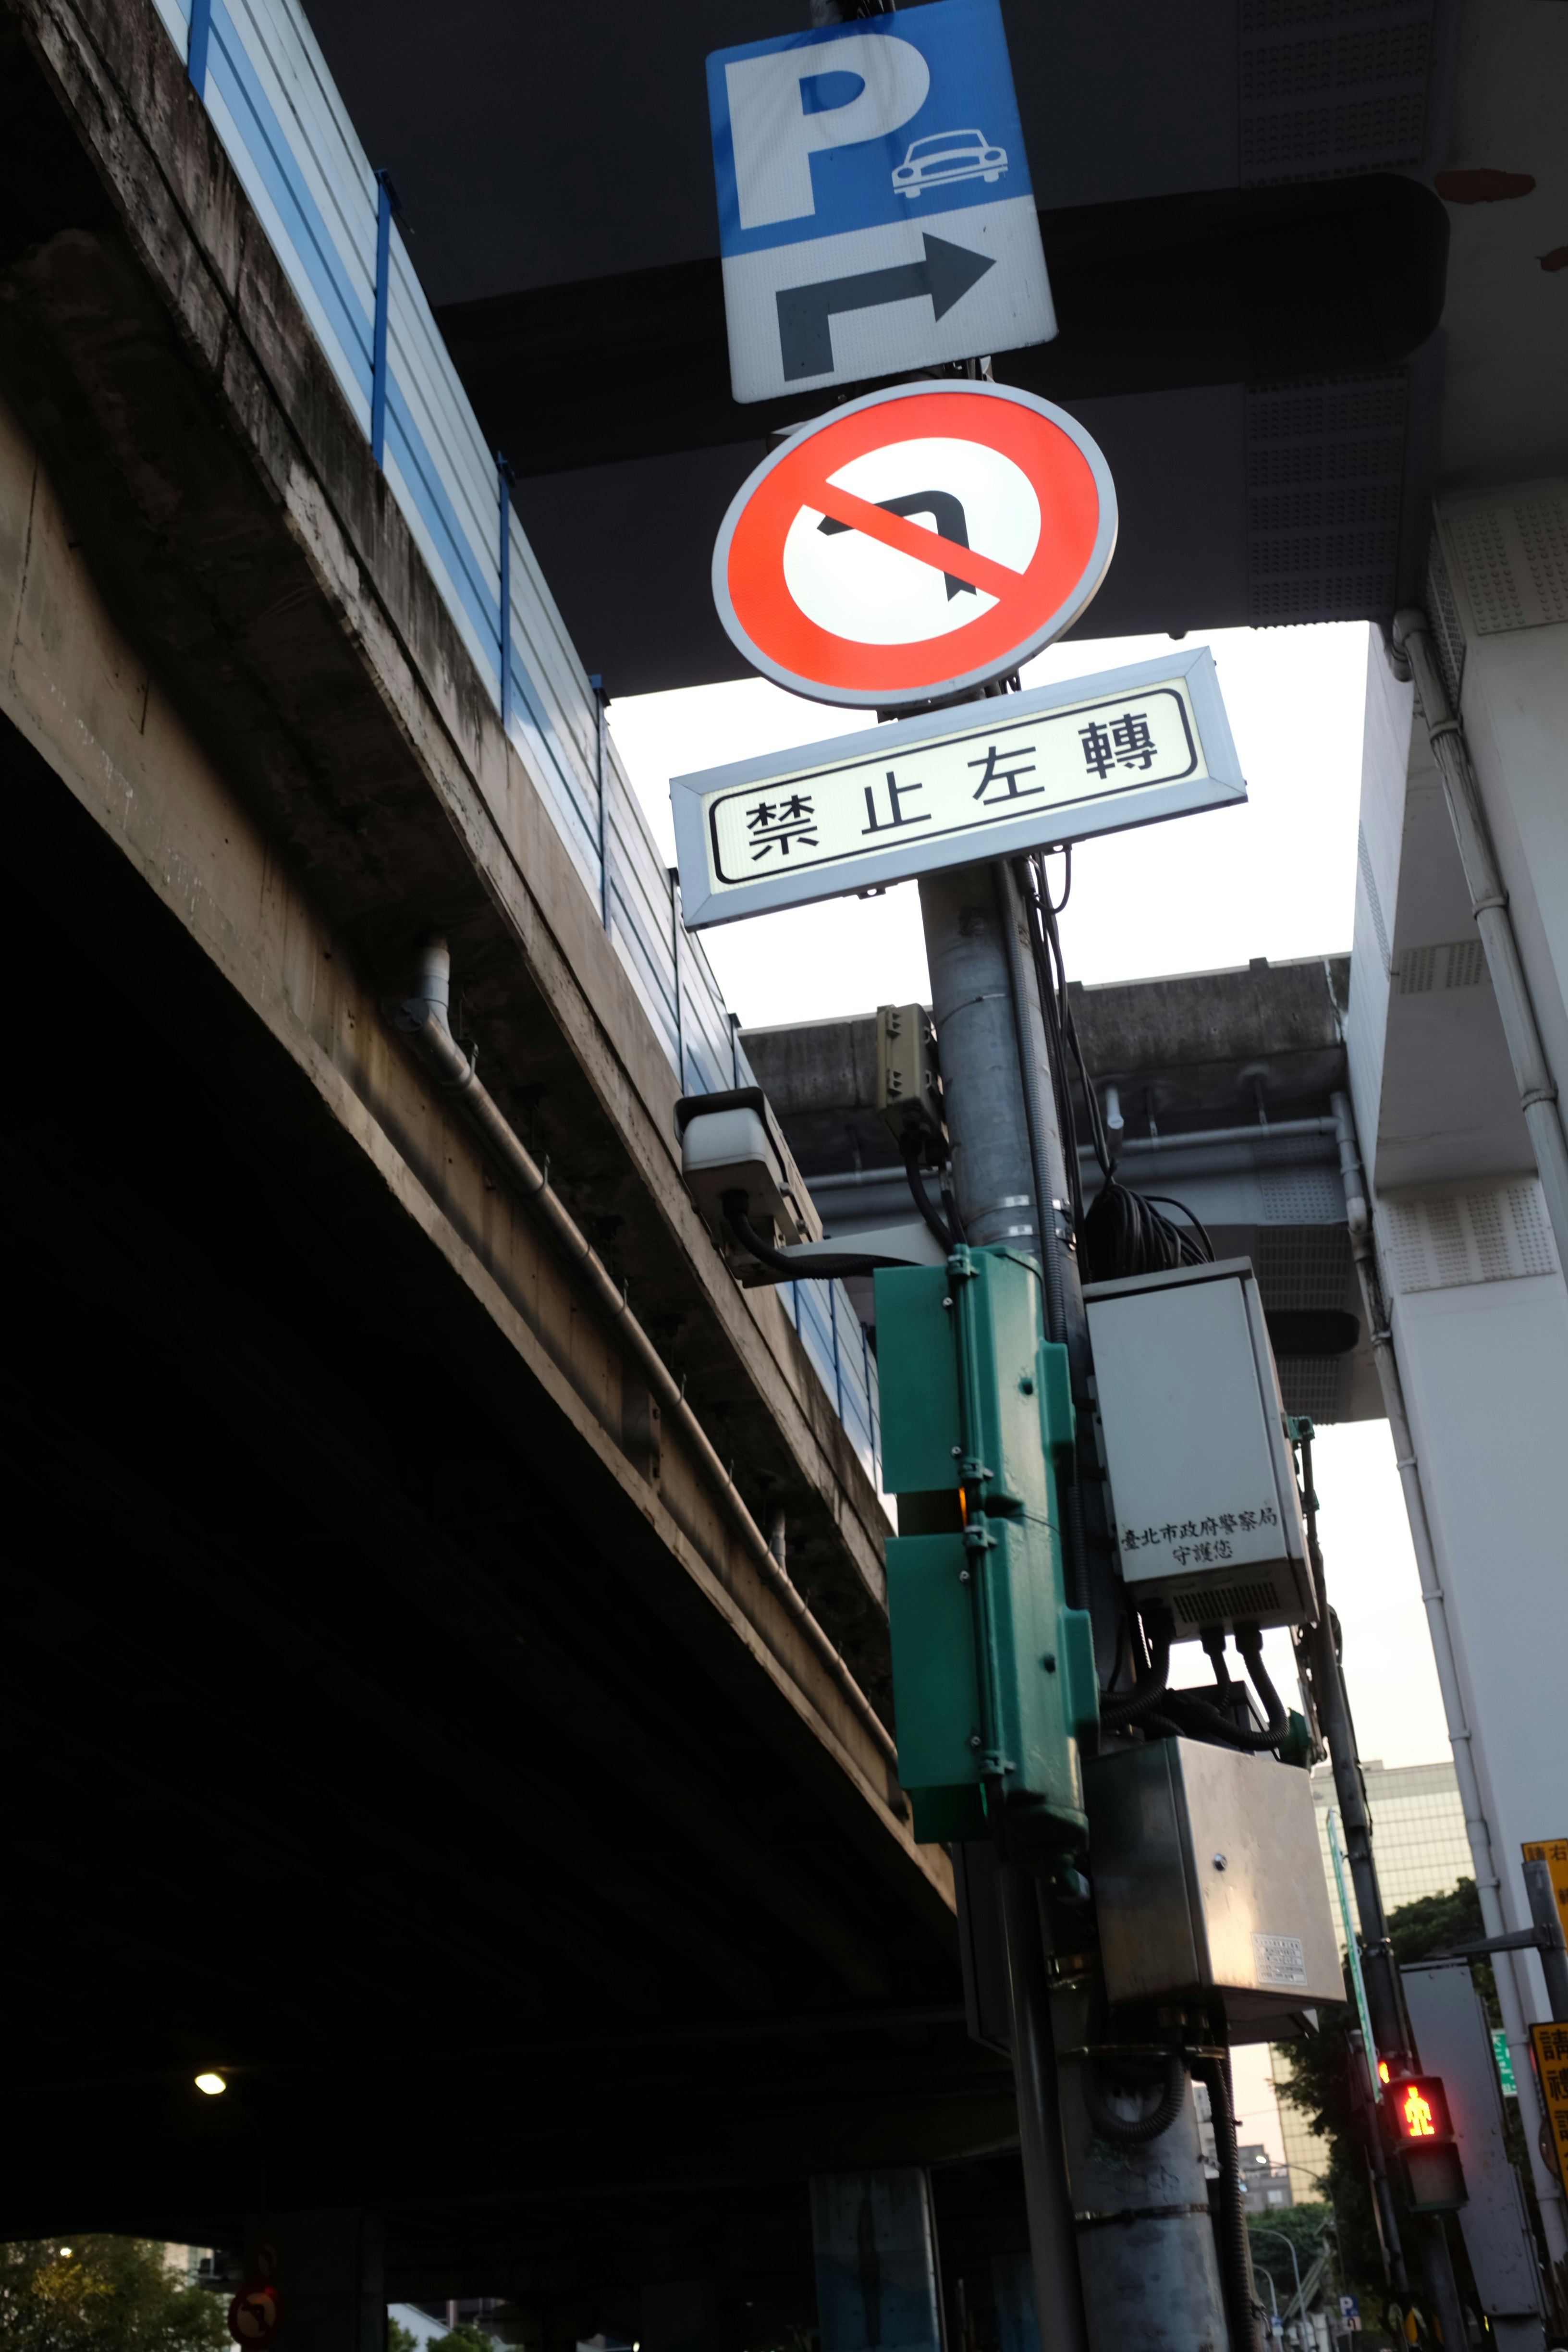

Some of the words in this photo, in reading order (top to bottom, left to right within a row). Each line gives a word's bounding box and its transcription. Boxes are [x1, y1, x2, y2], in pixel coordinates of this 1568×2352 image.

[725, 34, 930, 230] P
[746, 713, 1157, 860] 禁止左轉
[1121, 1508, 1277, 1551] 臺北市政府警察局
[1173, 1540, 1233, 1566] 守護您
[1339, 2297, 1353, 2315] P
